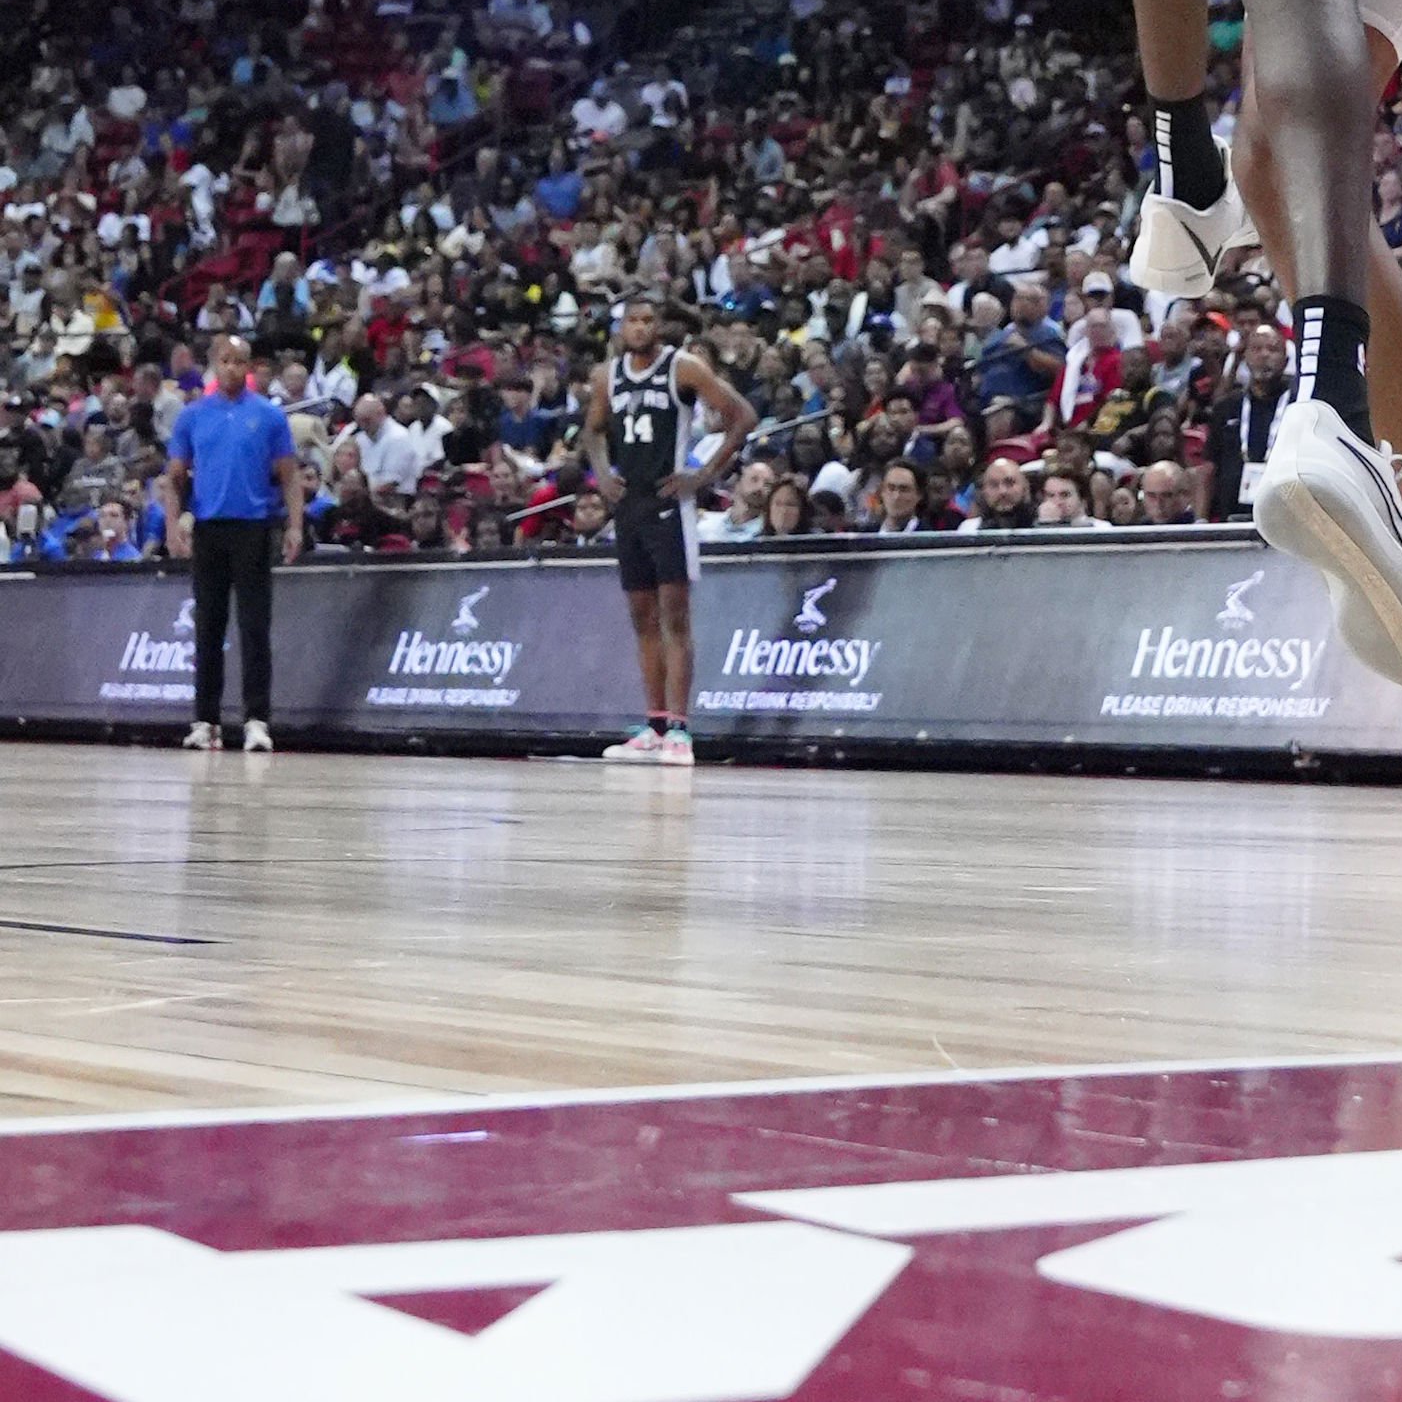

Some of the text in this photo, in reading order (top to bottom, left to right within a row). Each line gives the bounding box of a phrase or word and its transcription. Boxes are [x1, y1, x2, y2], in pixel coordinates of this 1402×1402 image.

[622, 413, 654, 444] 14
[119, 630, 197, 671] Henne
[388, 630, 523, 686] Hennessy
[722, 628, 882, 687] Hennessy
[1130, 626, 1328, 692] Hennessy
